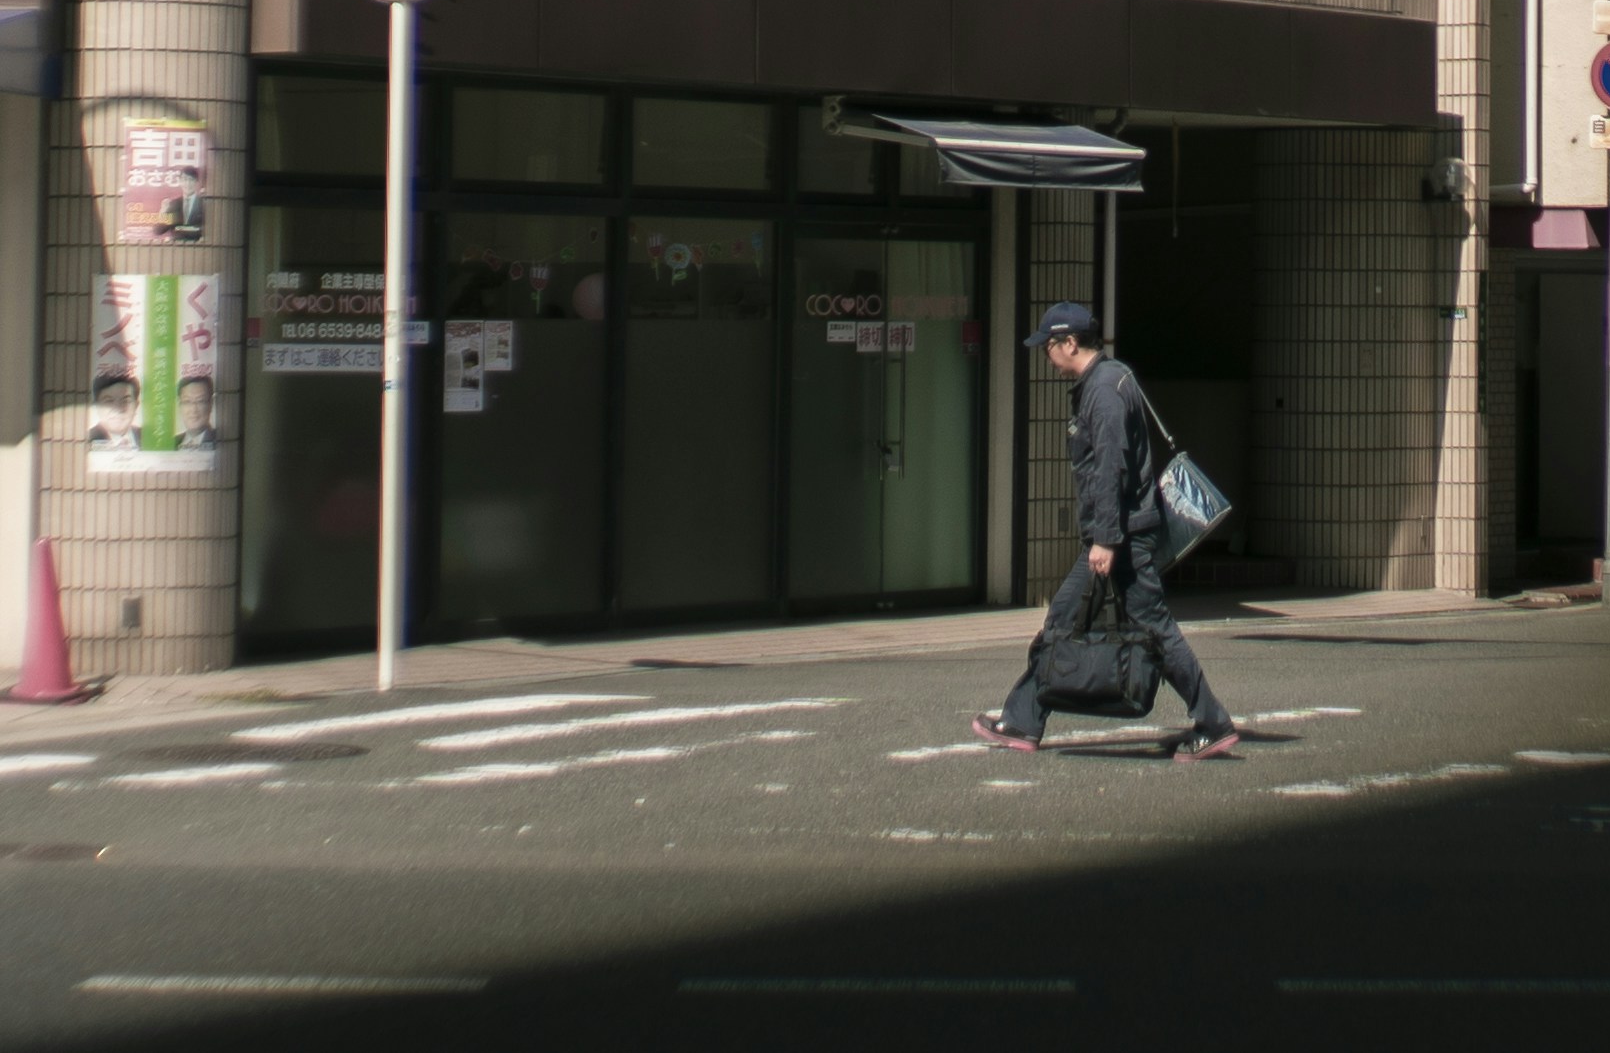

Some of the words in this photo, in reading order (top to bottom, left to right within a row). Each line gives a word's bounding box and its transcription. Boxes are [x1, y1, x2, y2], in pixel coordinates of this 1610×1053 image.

[129, 128, 201, 167] 吉田
[128, 169, 182, 187] おさむ
[97, 280, 137, 362] ミノベ
[182, 281, 213, 362] くや
